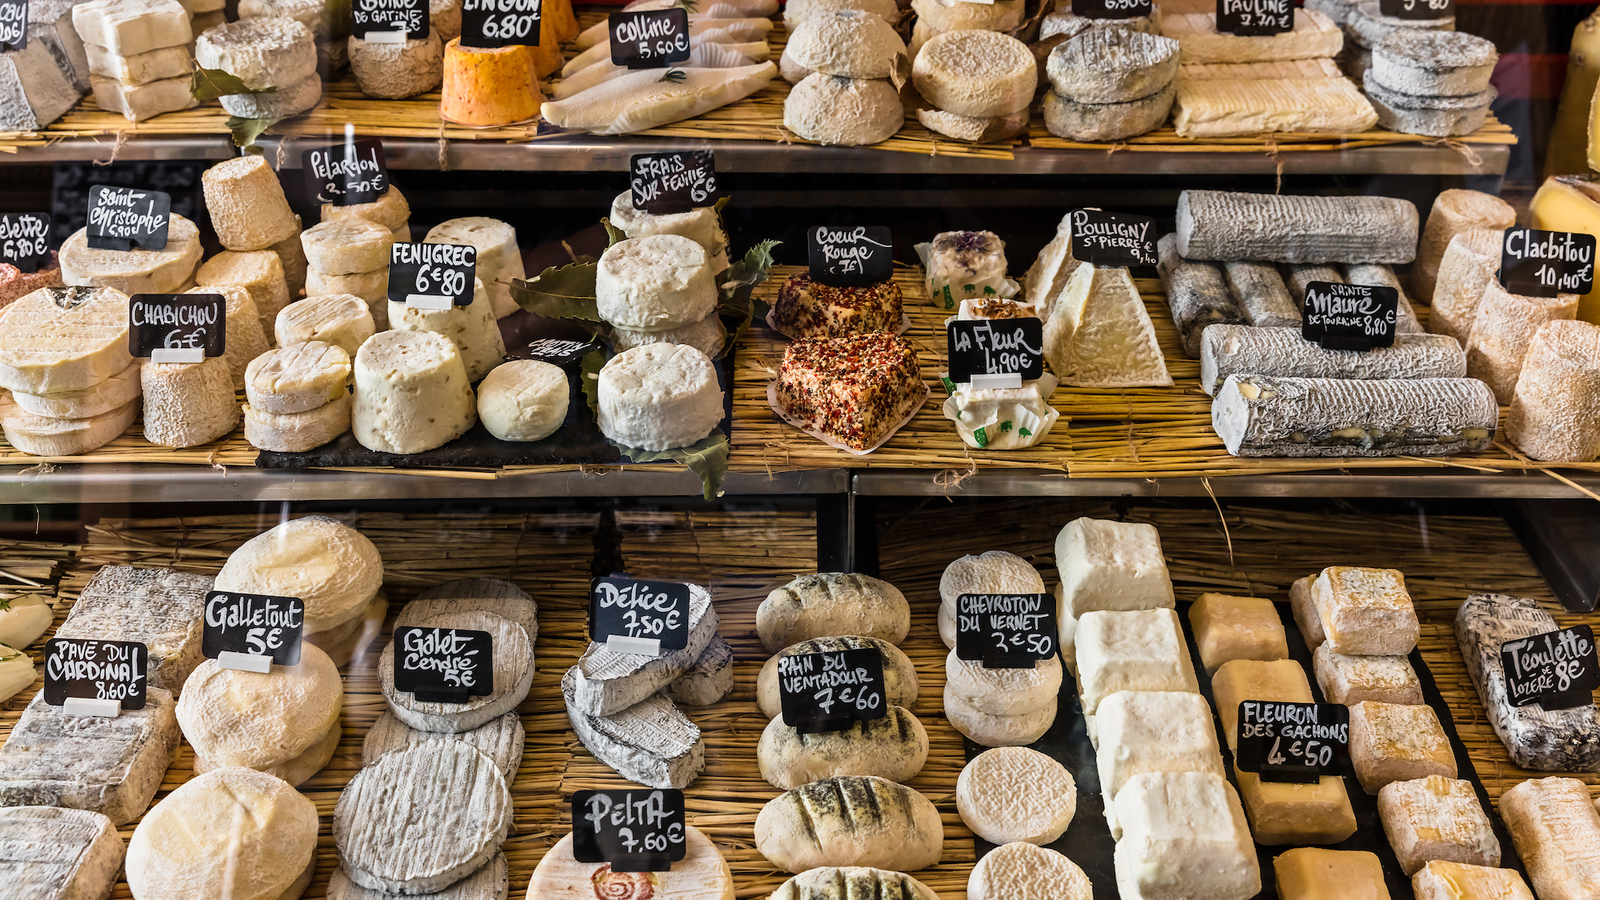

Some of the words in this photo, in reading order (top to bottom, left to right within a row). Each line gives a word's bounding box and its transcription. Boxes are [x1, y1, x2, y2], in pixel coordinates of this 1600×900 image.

[631, 178, 662, 206] SUR
[691, 177, 716, 202] 6€
[393, 243, 474, 267] FENUGREC
[131, 301, 217, 327] CHABICHOU
[164, 327, 206, 350] 6€
[960, 594, 1042, 614] CHEVROTON
[958, 614, 980, 632] DU
[990, 613, 1049, 631] VERNET
[245, 627, 283, 655] 5€
[102, 643, 129, 662] DU
[822, 653, 847, 671] DU
[443, 669, 476, 687] 5€
[783, 667, 874, 693] VENTADOUR
[1243, 703, 1318, 724] FLEURON
[1242, 722, 1275, 738] DES
[1281, 722, 1348, 744] GACHONS
